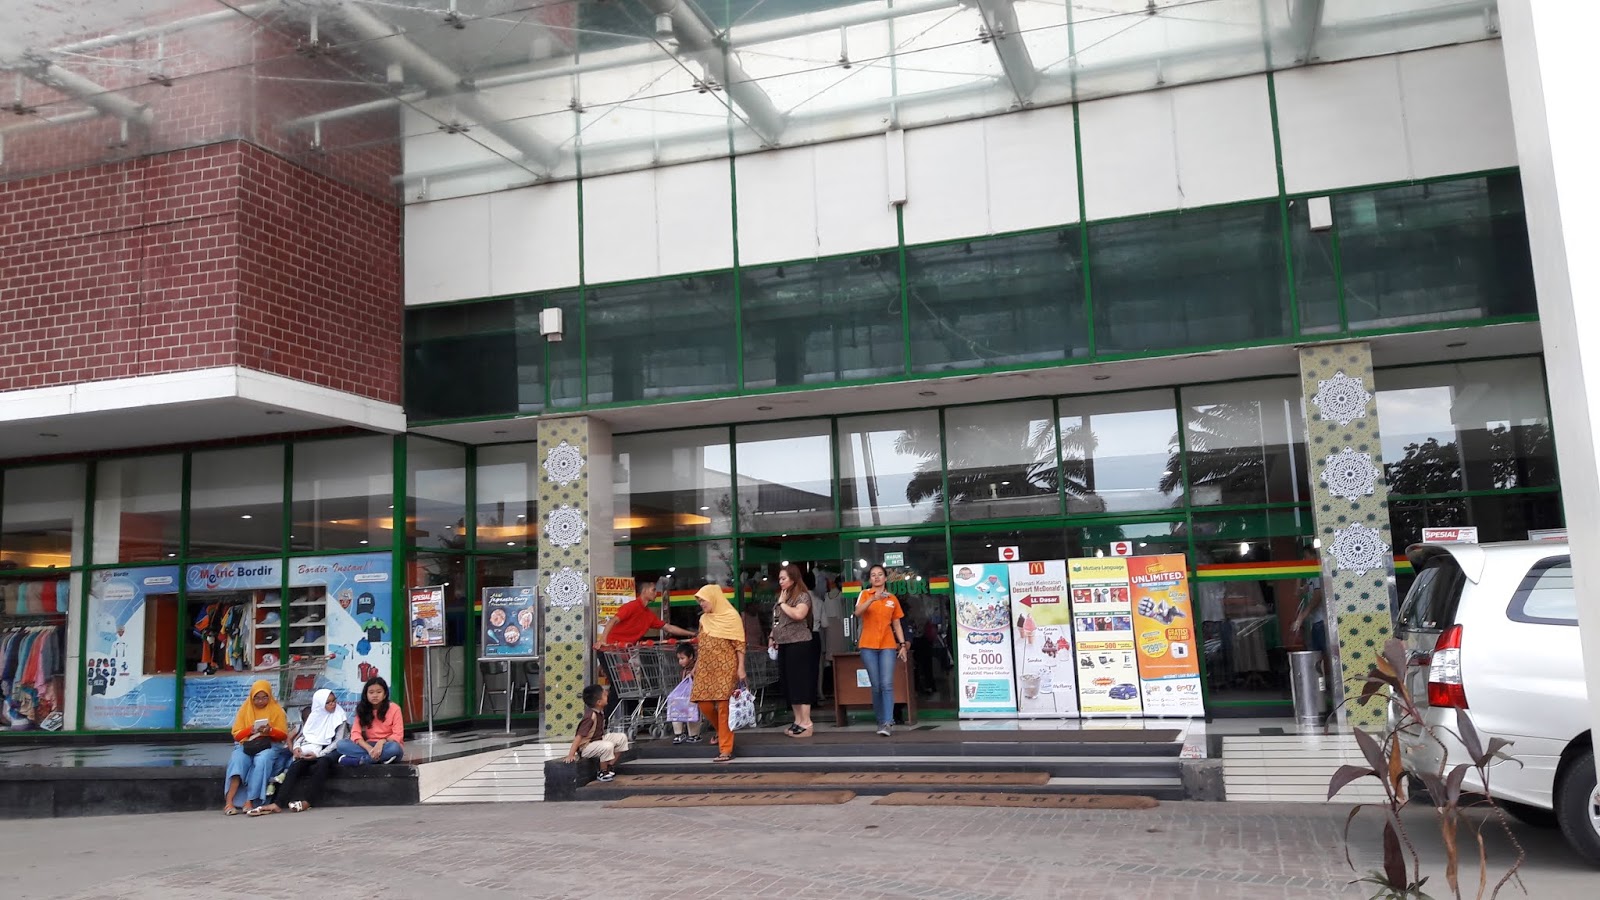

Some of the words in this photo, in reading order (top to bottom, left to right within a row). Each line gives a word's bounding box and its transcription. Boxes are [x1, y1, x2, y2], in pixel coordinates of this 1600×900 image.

[200, 567, 235, 584] Metric
[237, 566, 273, 577] Bordir
[298, 564, 328, 574] Bordir
[1131, 571, 1184, 584] UNLIMITED.
[606, 578, 634, 590] BEKANTAN
[971, 653, 1002, 665] 5.000
